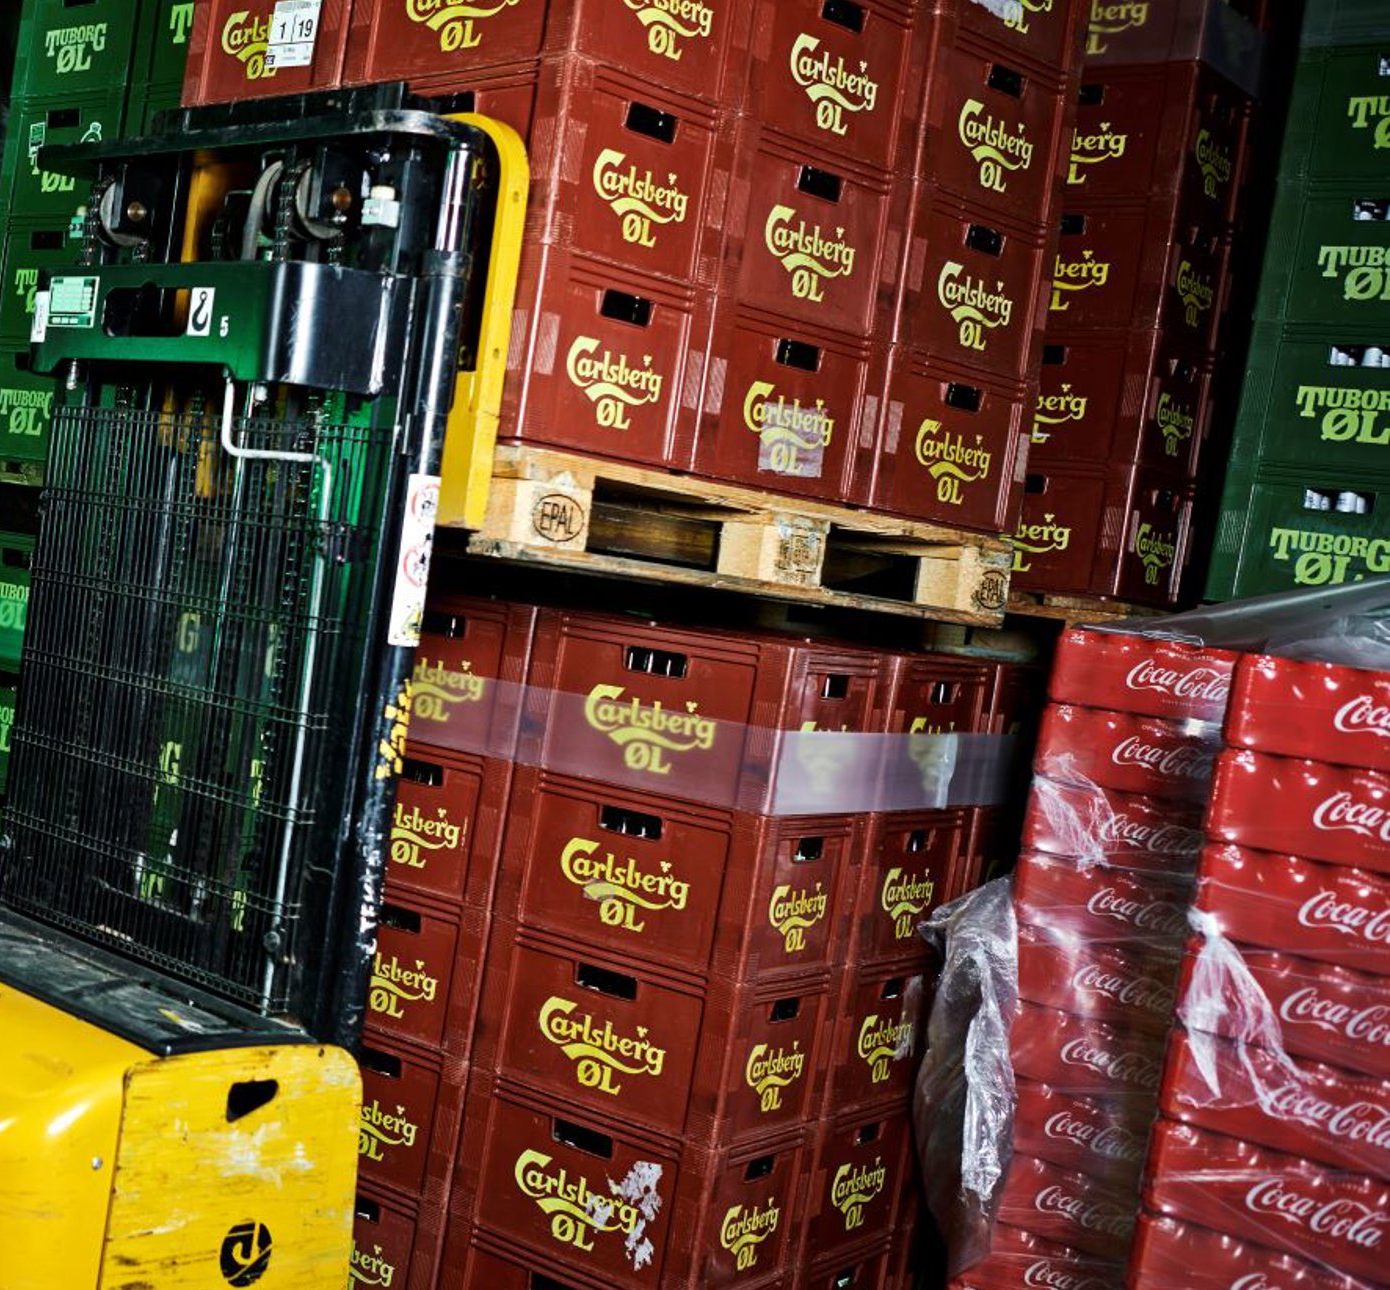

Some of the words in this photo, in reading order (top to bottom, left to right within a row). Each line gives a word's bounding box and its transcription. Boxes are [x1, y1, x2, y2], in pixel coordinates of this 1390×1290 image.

[222, 11, 273, 55] Carls
[441, 20, 482, 52] ØL
[1003, 8, 1031, 34] L
[46, 23, 107, 57] TUBORG
[648, 24, 683, 60] ØL
[56, 44, 91, 74] ØL
[790, 32, 878, 111] Carlsberg
[816, 100, 849, 136] ØL
[958, 98, 1034, 170] Carlsberg
[592, 148, 690, 224] Carlsberg
[980, 161, 1007, 193] ØL
[622, 215, 657, 248] ØL
[765, 204, 856, 276] Carlsberg
[792, 271, 825, 303] ØL
[937, 260, 1013, 329] Carlsberg
[220, 316, 230, 338] 5
[960, 321, 987, 351] ØL
[566, 335, 663, 406] Carlsberg
[596, 397, 631, 430] ØL
[743, 380, 835, 448] Carlsberg
[1296, 386, 1390, 418] TUBOR
[9, 406, 42, 436] ØL
[1320, 408, 1390, 445] ØL
[769, 443, 805, 475] ØL
[915, 418, 991, 483] Carlsberg
[937, 475, 965, 506] ØL
[540, 501, 574, 535] EPAL
[413, 657, 485, 702] rlsberg
[415, 694, 450, 722] ØL
[585, 684, 716, 751] Carlsberg
[623, 743, 672, 774] ØL
[392, 803, 462, 850] lsberg
[391, 841, 426, 869] ØL
[561, 837, 691, 910] Carlsberg
[770, 882, 828, 934] Carlsberg
[882, 867, 935, 919] Carlsberg
[599, 899, 645, 932] ØL
[895, 914, 914, 939] ØL
[784, 927, 807, 954] ØL
[373, 952, 439, 1001] lsberg
[369, 990, 405, 1019] ØL
[539, 996, 666, 1076] Carlsberg
[858, 1011, 912, 1064] Carlsberg
[577, 1060, 622, 1096] ØL
[746, 1041, 805, 1095] Carlsberg
[872, 1058, 891, 1083] ØL
[761, 1086, 783, 1113] ØL
[360, 1100, 418, 1147] sberg
[514, 1149, 641, 1234] Carlsberg
[831, 1156, 886, 1213] Carlsberg
[551, 1214, 595, 1252] ØL
[721, 1197, 781, 1252] Carlsberg
[845, 1204, 865, 1232] ØL
[736, 1245, 758, 1272] ØL
